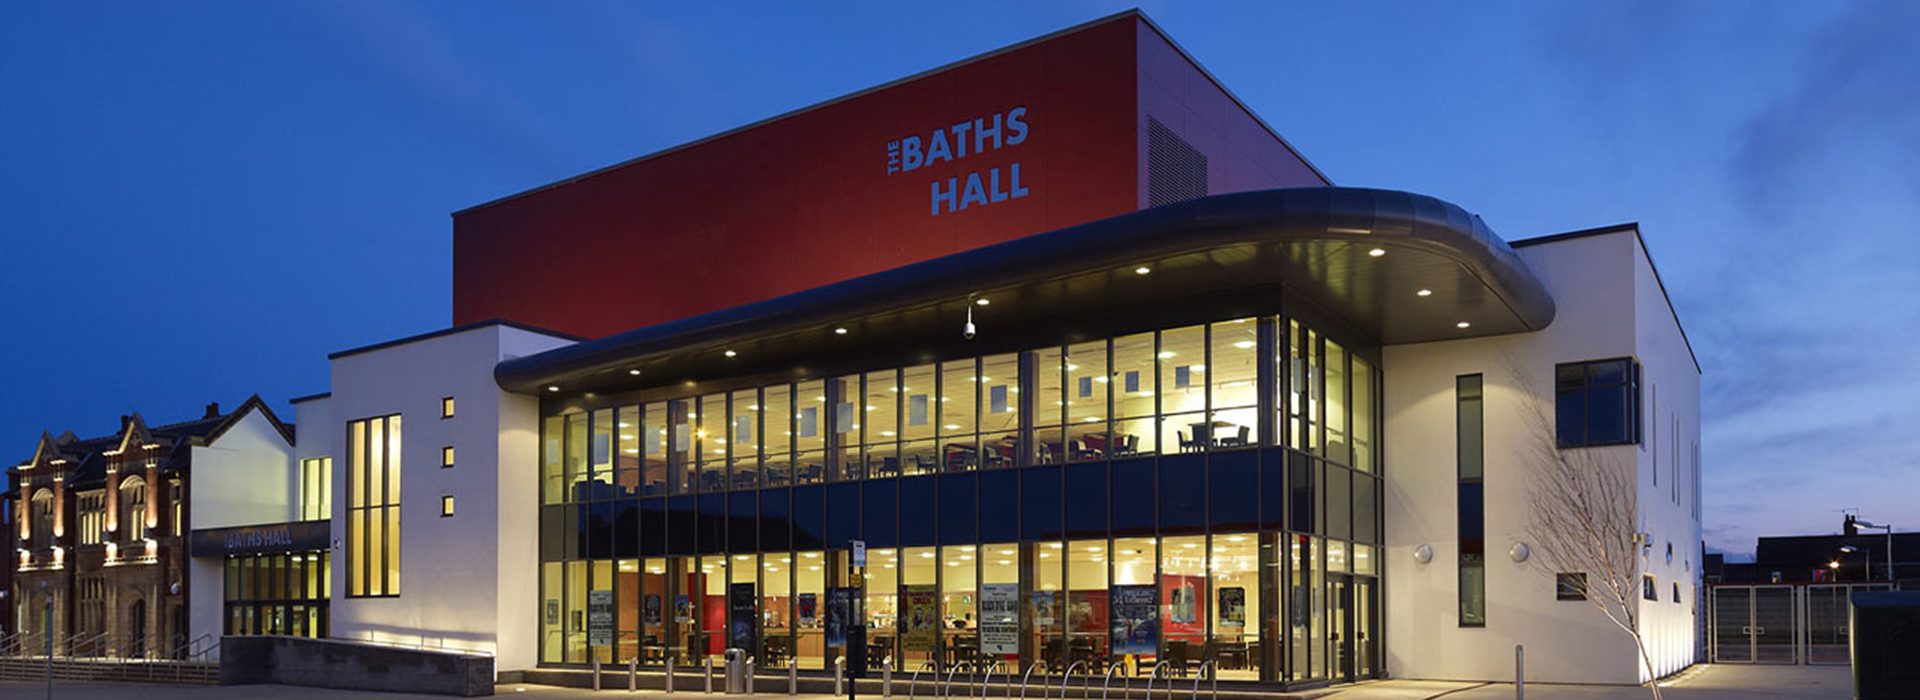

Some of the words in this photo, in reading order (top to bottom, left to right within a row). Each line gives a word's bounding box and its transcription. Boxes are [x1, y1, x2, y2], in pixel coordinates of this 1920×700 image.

[887, 140, 900, 174] THE
[902, 107, 1029, 172] BATHS
[931, 162, 1030, 216] HALL
[228, 530, 262, 548] BATHS
[264, 528, 292, 546] HALL
